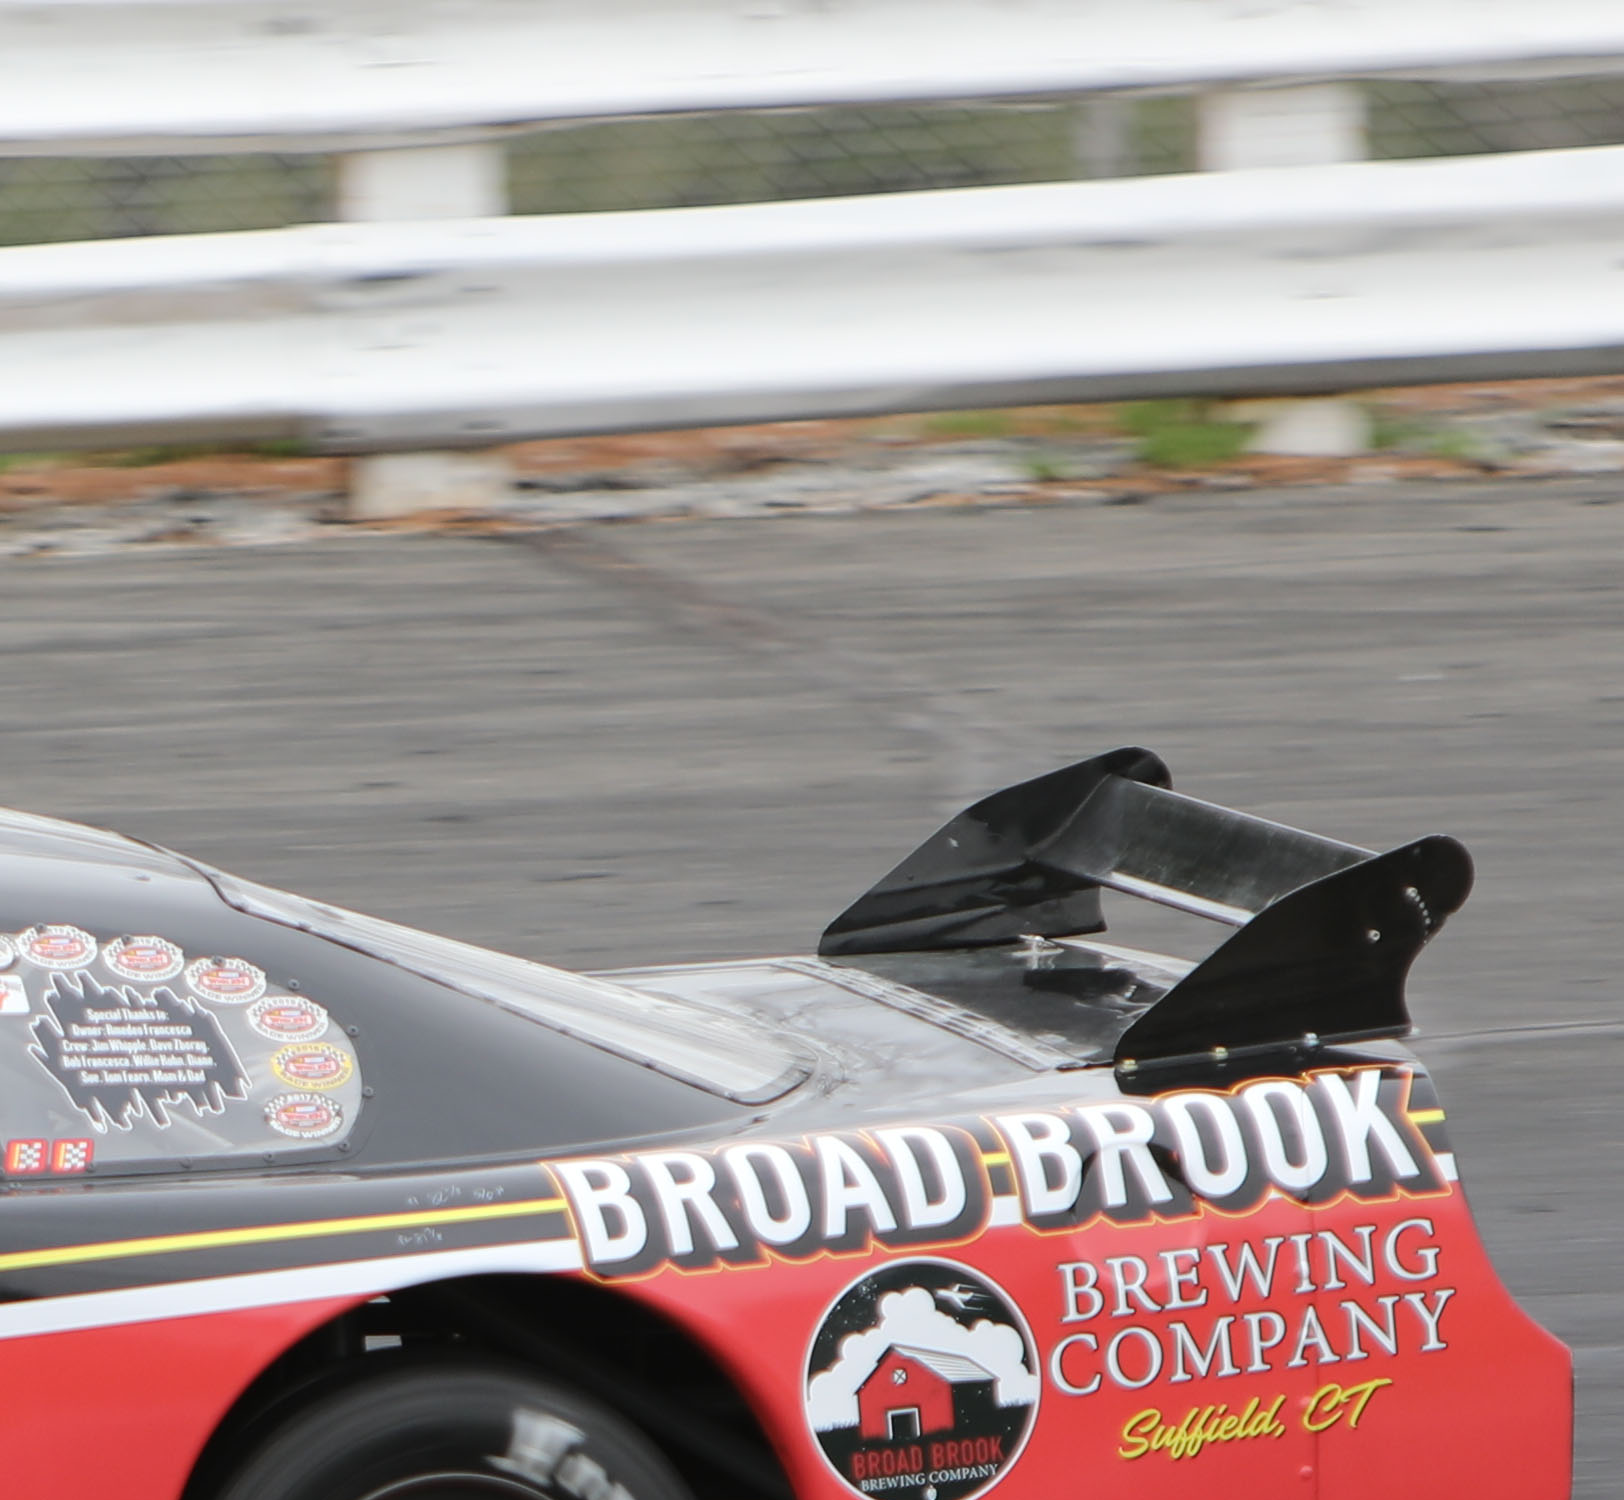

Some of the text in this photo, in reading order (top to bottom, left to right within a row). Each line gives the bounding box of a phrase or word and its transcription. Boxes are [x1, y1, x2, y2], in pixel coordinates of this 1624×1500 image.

[86, 1008, 122, 1023] Special
[123, 1008, 155, 1020] Thanks
[555, 1068, 1426, 1272] BROAD BROOK
[1055, 1217, 1442, 1324] BREWING
[1049, 1288, 1456, 1397] COMPANY
[852, 1436, 1005, 1480] BROAD BROOK
[1117, 1377, 1394, 1460] Suffield, CT
[860, 1463, 1000, 1492] BREWING COMPANY
